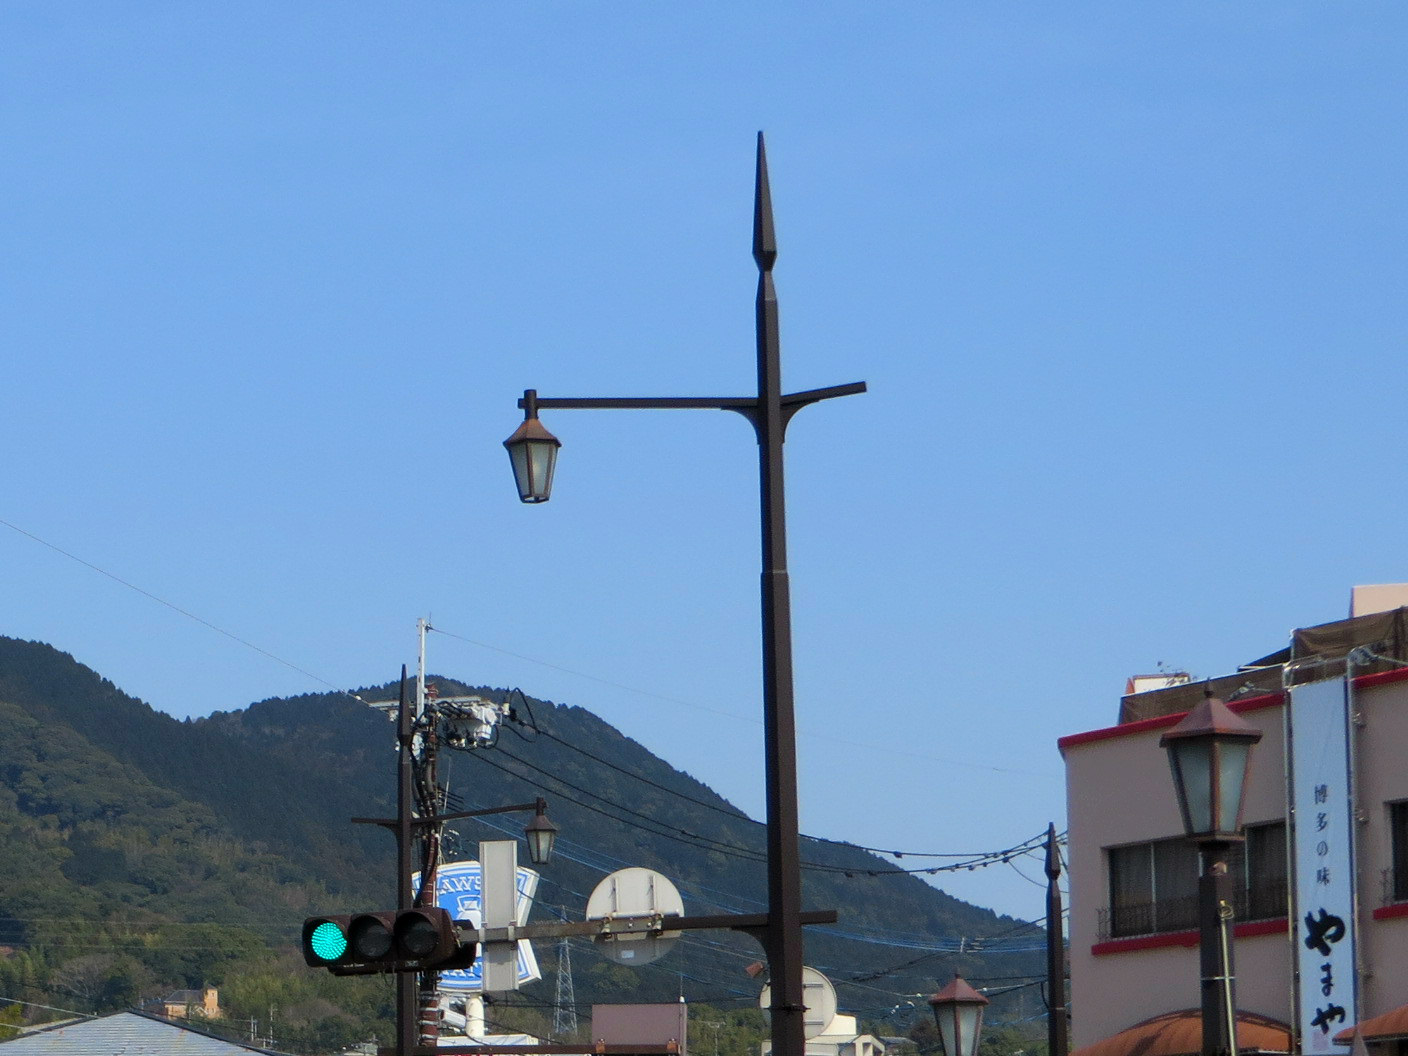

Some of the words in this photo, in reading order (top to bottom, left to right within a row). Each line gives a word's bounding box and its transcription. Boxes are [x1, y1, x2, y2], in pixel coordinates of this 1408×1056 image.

[1313, 784, 1330, 887] 博多の味
[1304, 907, 1346, 1035] やまや
